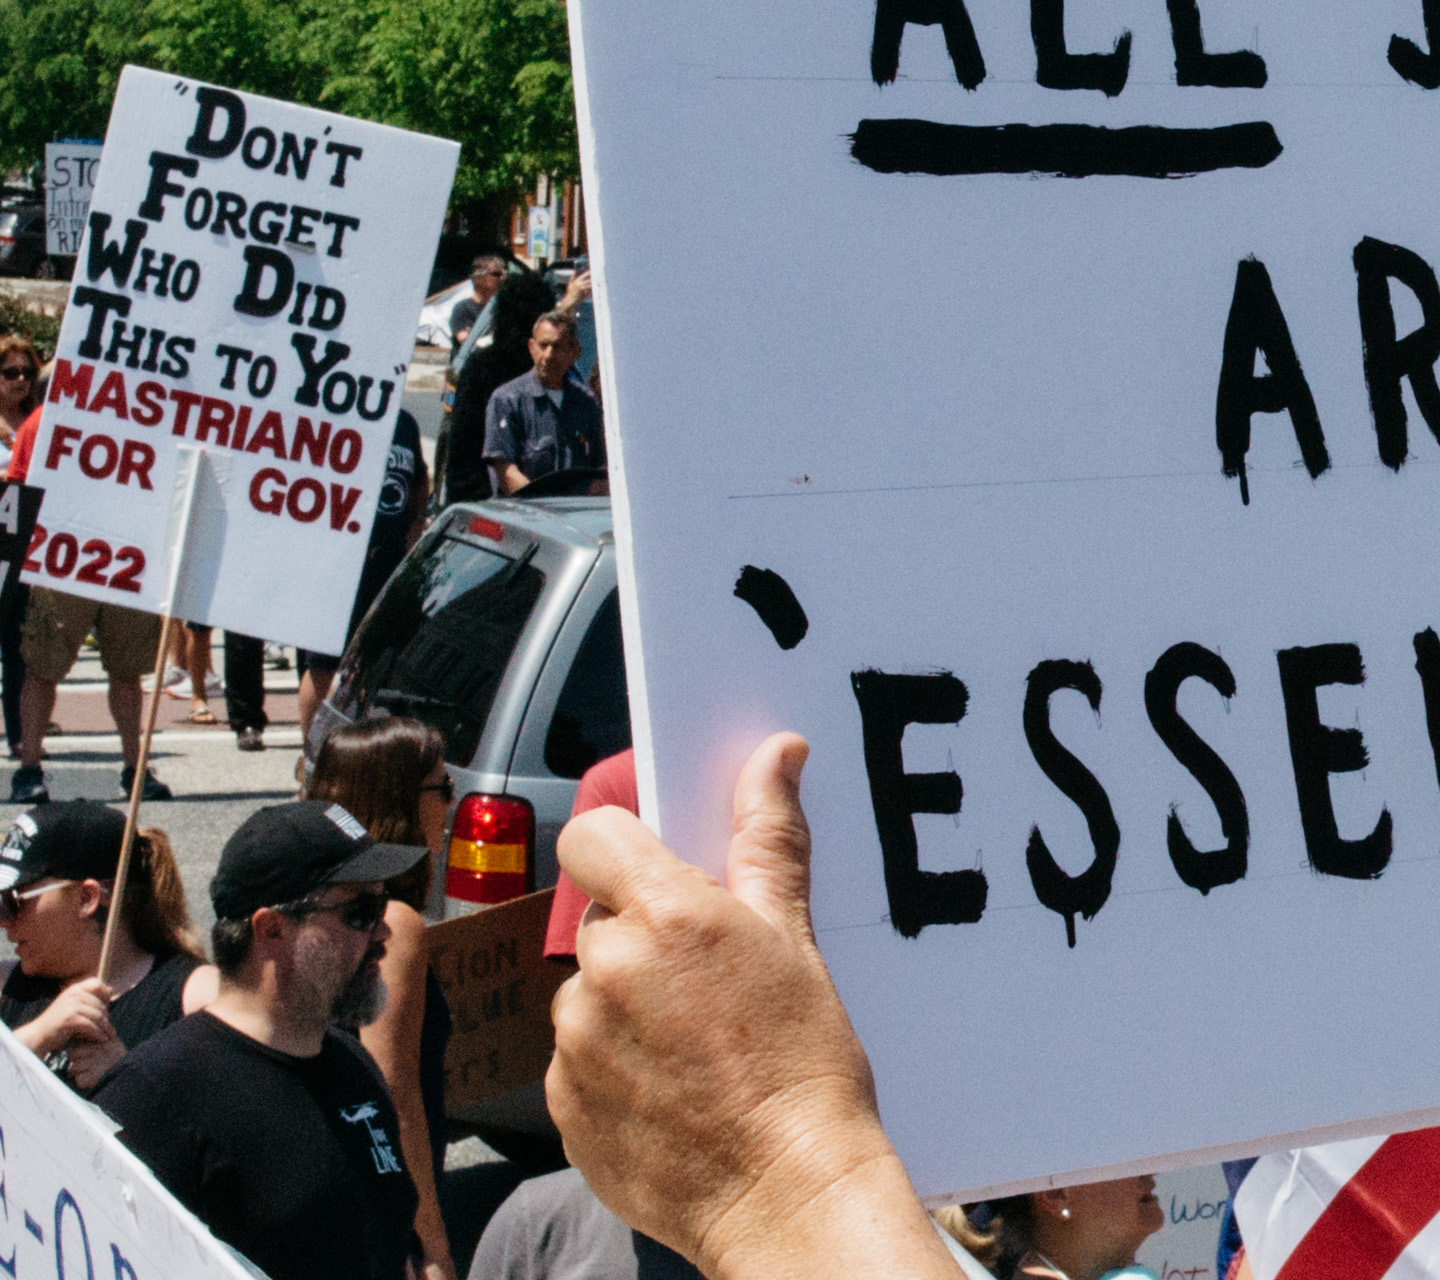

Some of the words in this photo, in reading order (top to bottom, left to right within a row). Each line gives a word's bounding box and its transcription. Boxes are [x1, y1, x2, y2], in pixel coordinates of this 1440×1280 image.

[85, 211, 201, 303] WHO
[233, 245, 346, 332] DID
[72, 286, 196, 381] THIS
[216, 343, 277, 399] TO
[47, 357, 363, 476] MASTRIANO
[45, 423, 156, 490] FOR
[248, 474, 362, 534] GOV.
[20, 530, 147, 595] 2022
